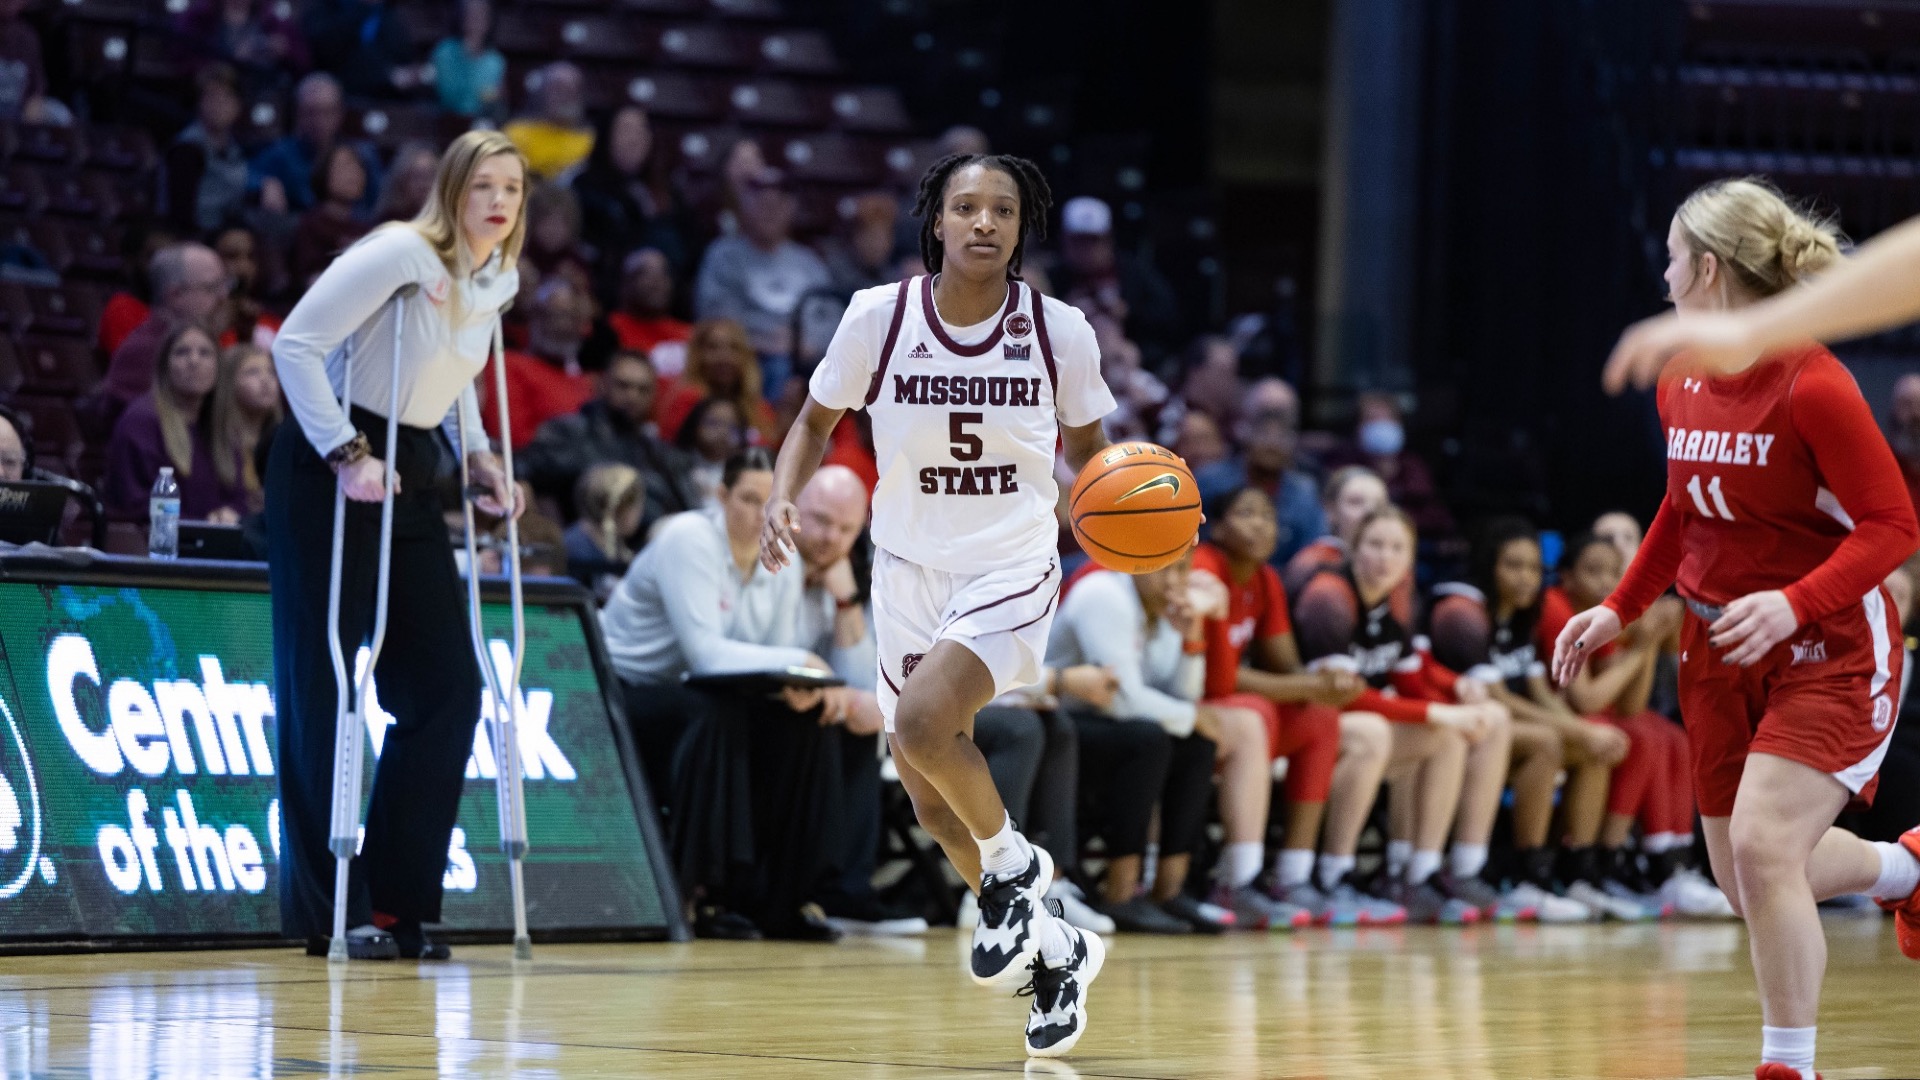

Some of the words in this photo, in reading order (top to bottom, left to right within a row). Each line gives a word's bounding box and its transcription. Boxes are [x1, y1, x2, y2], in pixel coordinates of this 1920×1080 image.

[907, 351, 933, 359] adidas
[894, 374, 1041, 406] MISSOURI
[949, 412, 983, 461] 5
[919, 464, 1019, 495] STATE
[1686, 474, 1736, 521] 11
[47, 632, 277, 778] Centr
[97, 788, 163, 894] of
[163, 788, 267, 894] the
